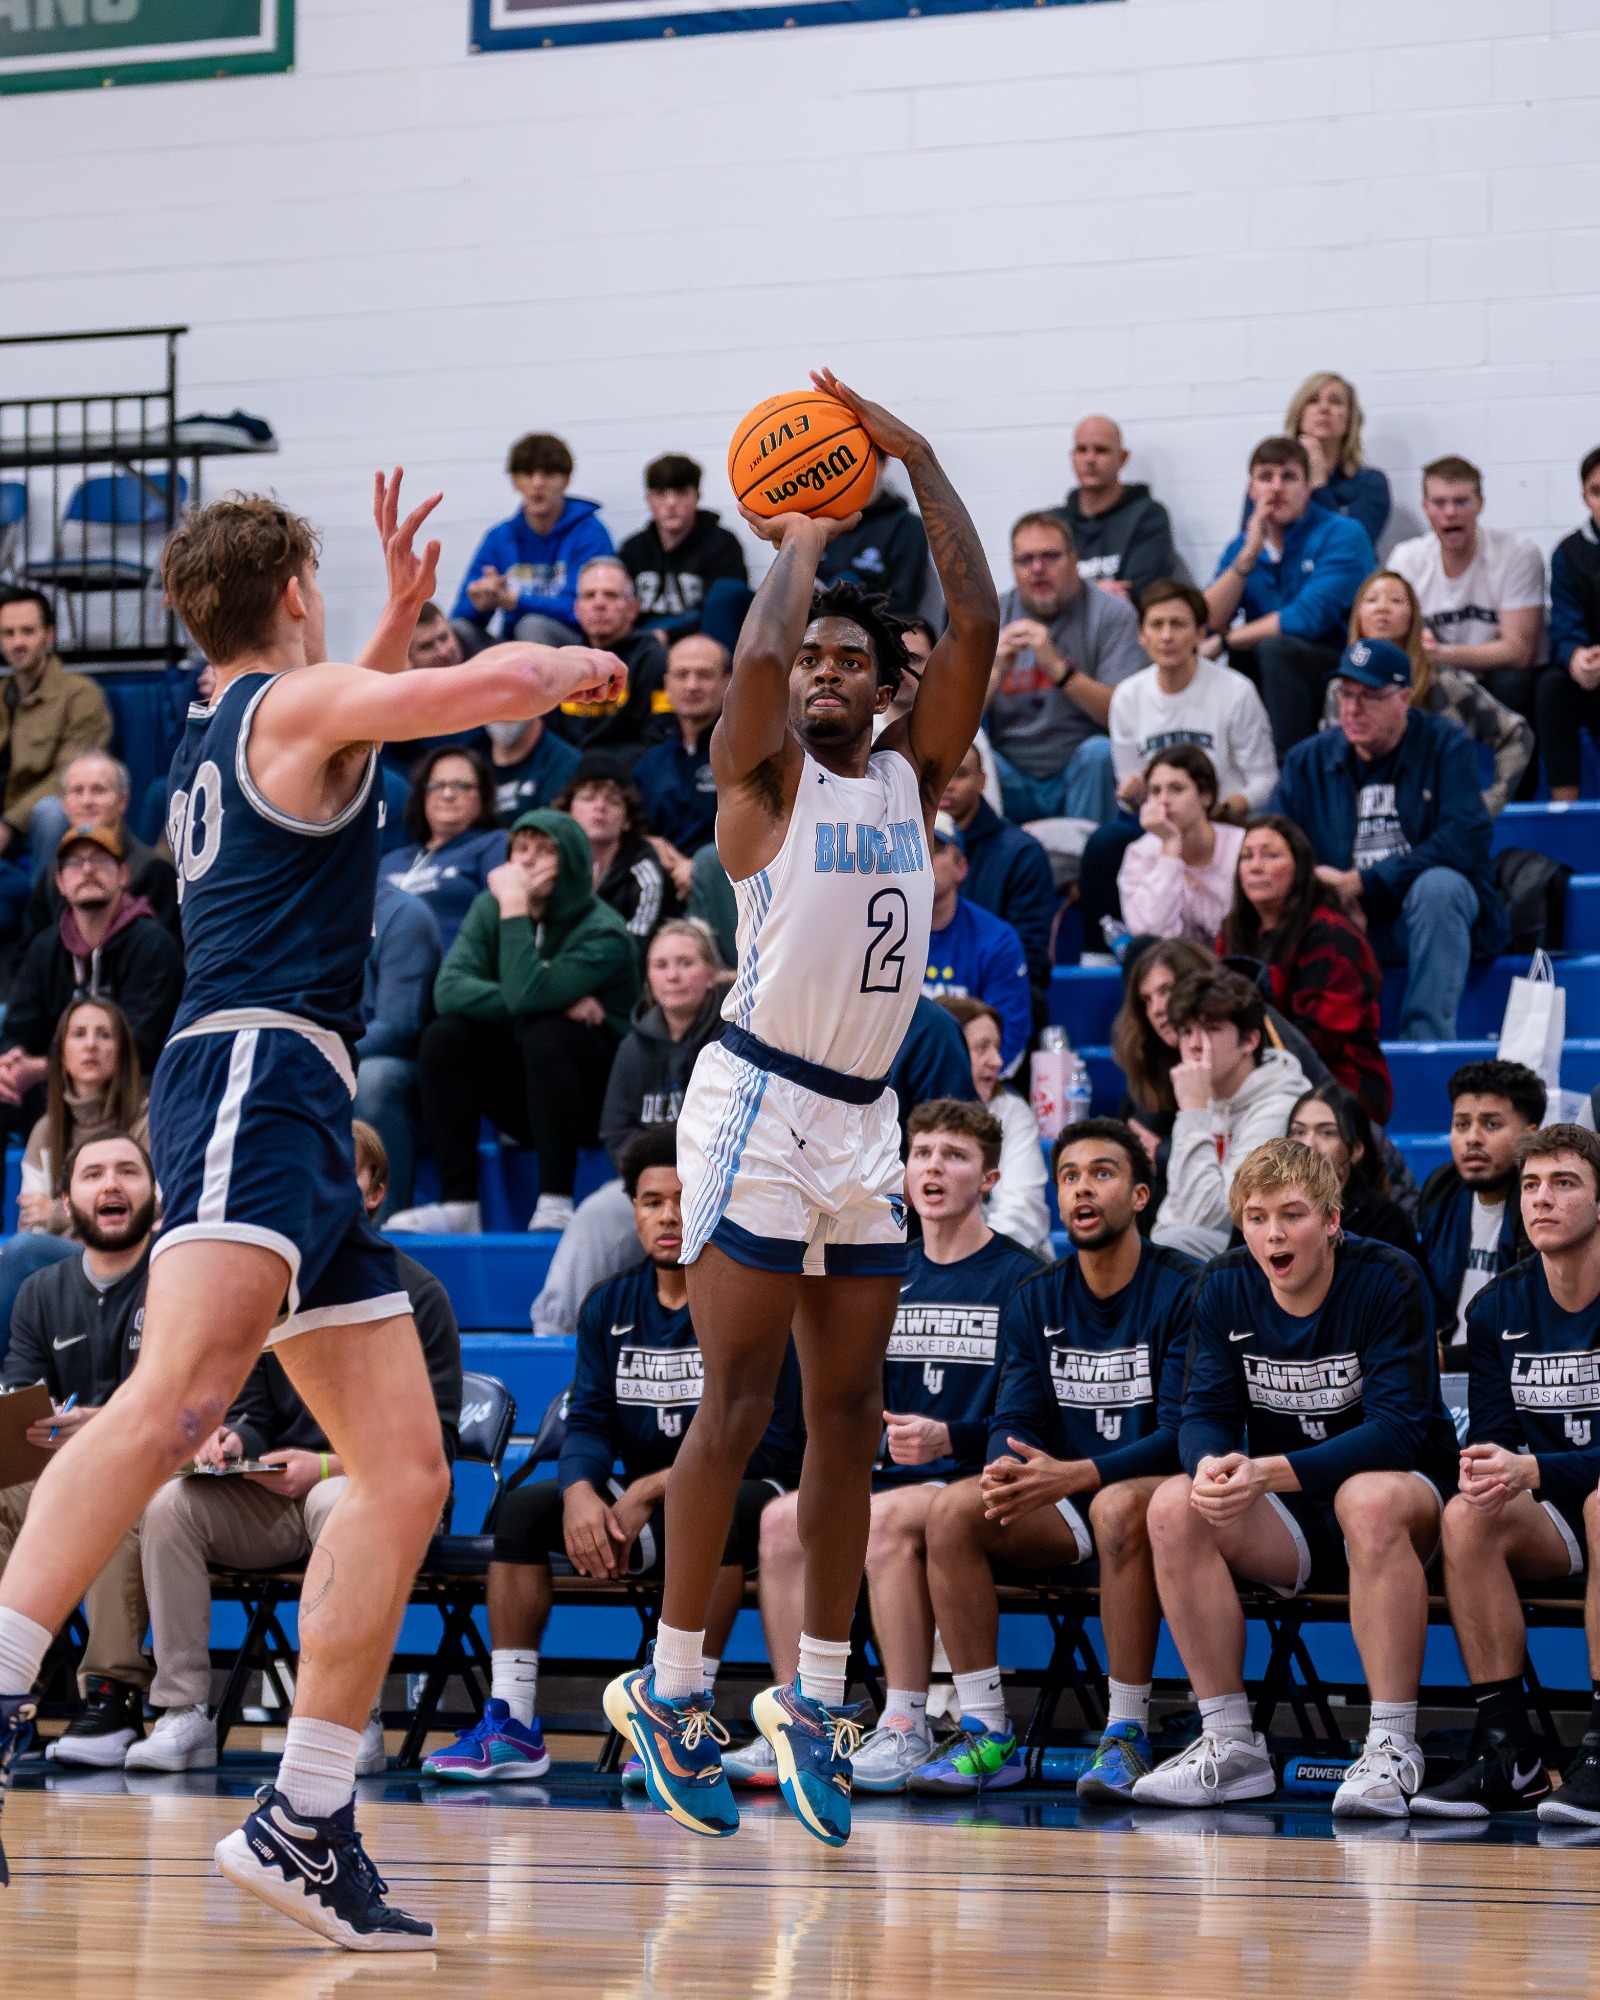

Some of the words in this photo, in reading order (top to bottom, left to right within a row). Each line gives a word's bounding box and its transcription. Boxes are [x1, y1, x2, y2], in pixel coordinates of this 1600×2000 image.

[759, 414, 811, 459] EVO
[764, 444, 858, 505] Wilson
[860, 887, 909, 993] 2
[891, 1309, 999, 1338] AWRENCE
[621, 1383, 701, 1398] BASKETBA
[1243, 1357, 1362, 1392] LAWRENCE
